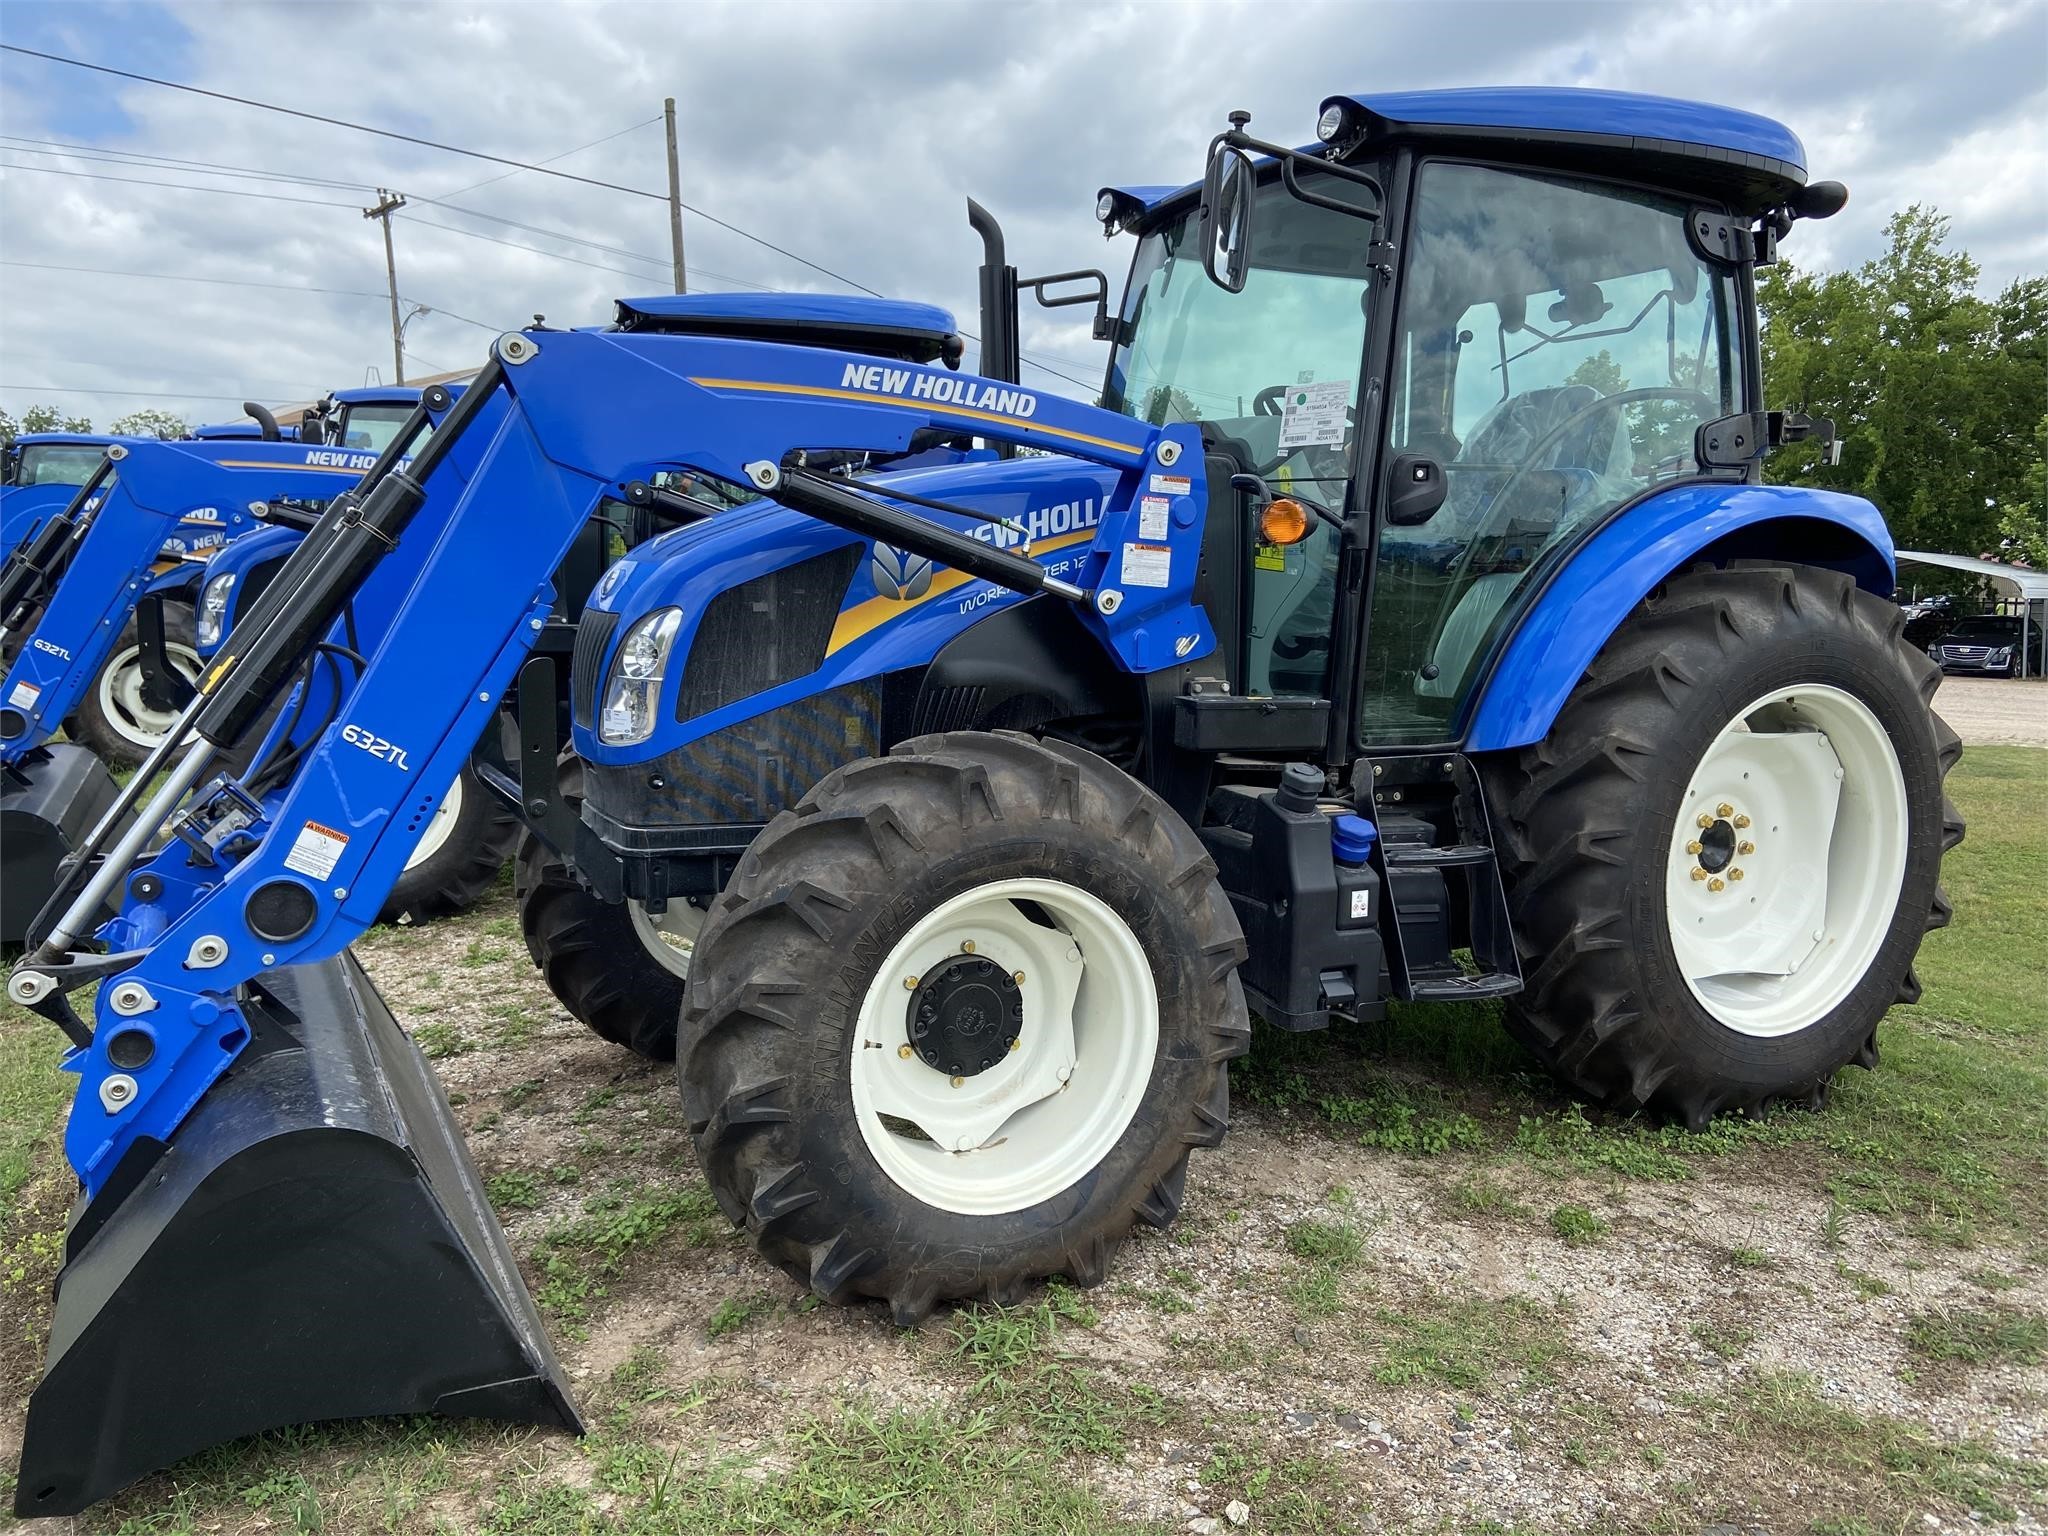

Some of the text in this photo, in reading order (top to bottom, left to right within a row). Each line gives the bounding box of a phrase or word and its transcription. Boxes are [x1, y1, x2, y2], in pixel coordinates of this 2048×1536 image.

[841, 363, 1037, 418] NEW HOLLAND
[306, 450, 349, 467] NEW
[193, 532, 226, 550] NEW
[34, 639, 71, 661] 632TL
[342, 724, 409, 771] 632TL
[314, 825, 349, 844] WARNING
[813, 890, 918, 1081] ALLIANCE
